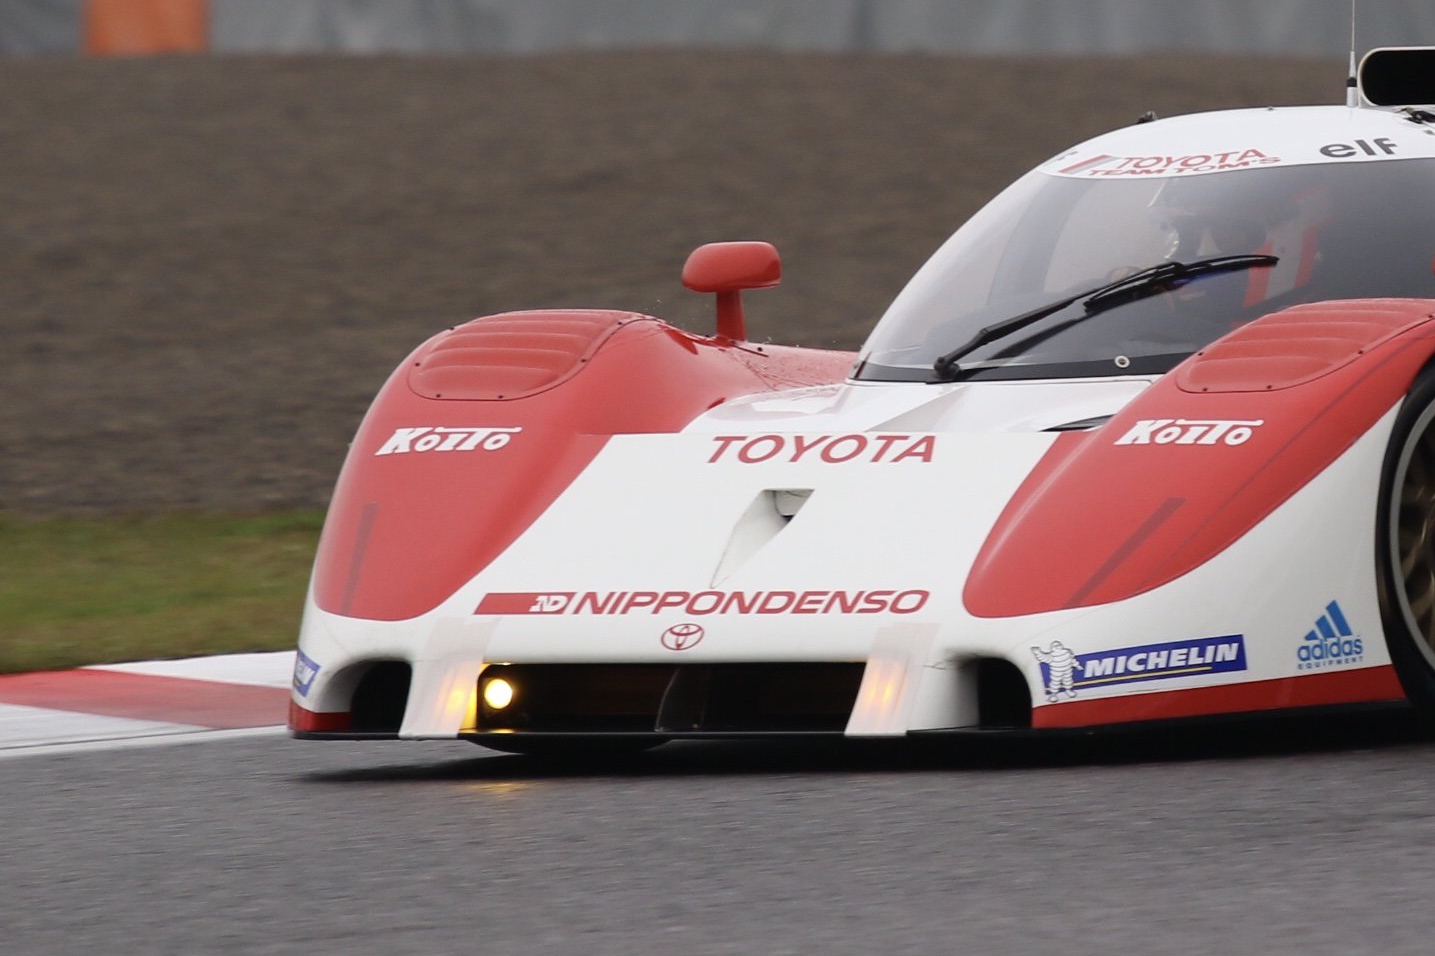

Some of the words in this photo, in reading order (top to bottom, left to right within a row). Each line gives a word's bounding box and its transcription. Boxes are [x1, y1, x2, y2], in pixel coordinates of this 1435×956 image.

[1117, 148, 1268, 169] TOYOTA
[1319, 137, 1398, 158] elf
[707, 434, 936, 464] TOYOTA
[572, 589, 931, 615] NIPPONDENSO
[1082, 642, 1240, 679] MICHELIN
[1297, 636, 1363, 662] adidas
[1297, 656, 1363, 670] EQUIPMENT
